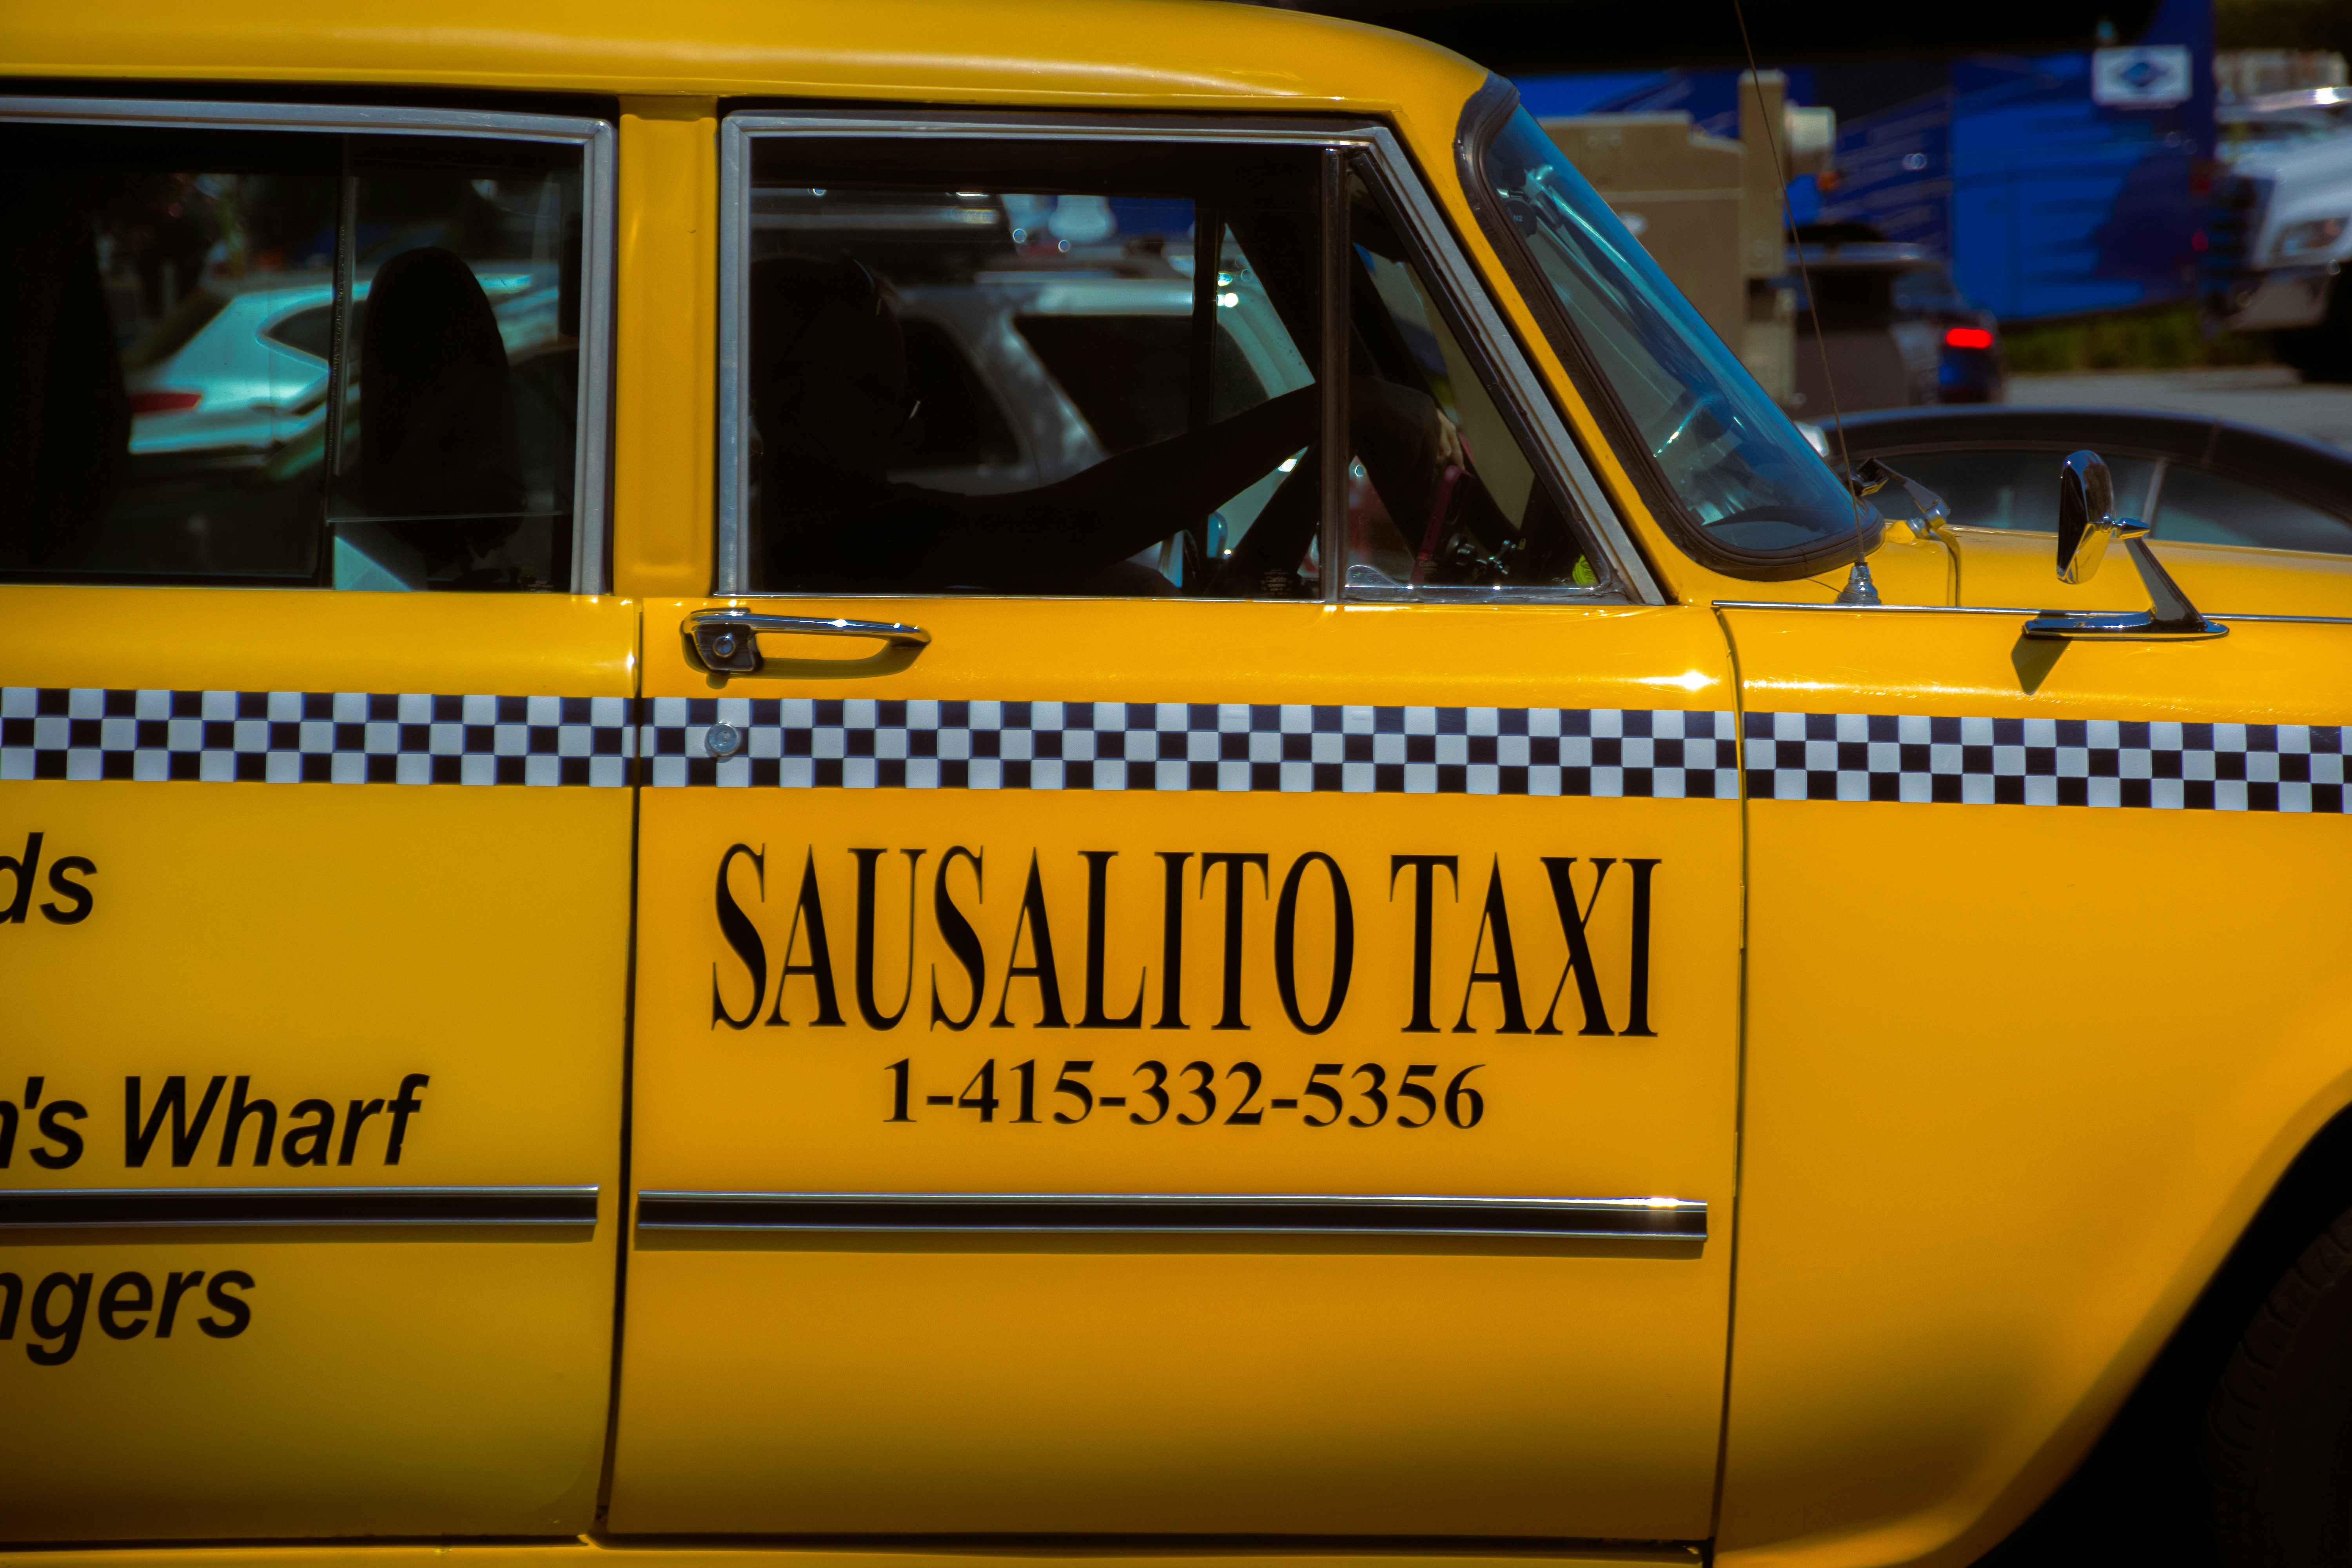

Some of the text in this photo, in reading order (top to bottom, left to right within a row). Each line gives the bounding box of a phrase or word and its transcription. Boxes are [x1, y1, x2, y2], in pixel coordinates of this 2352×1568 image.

[0, 831, 98, 926] ds
[711, 843, 1662, 1037] SAUSALITO TAXI
[124, 1073, 430, 1168] Wharf
[883, 1058, 1486, 1129] 1-415-332-5356
